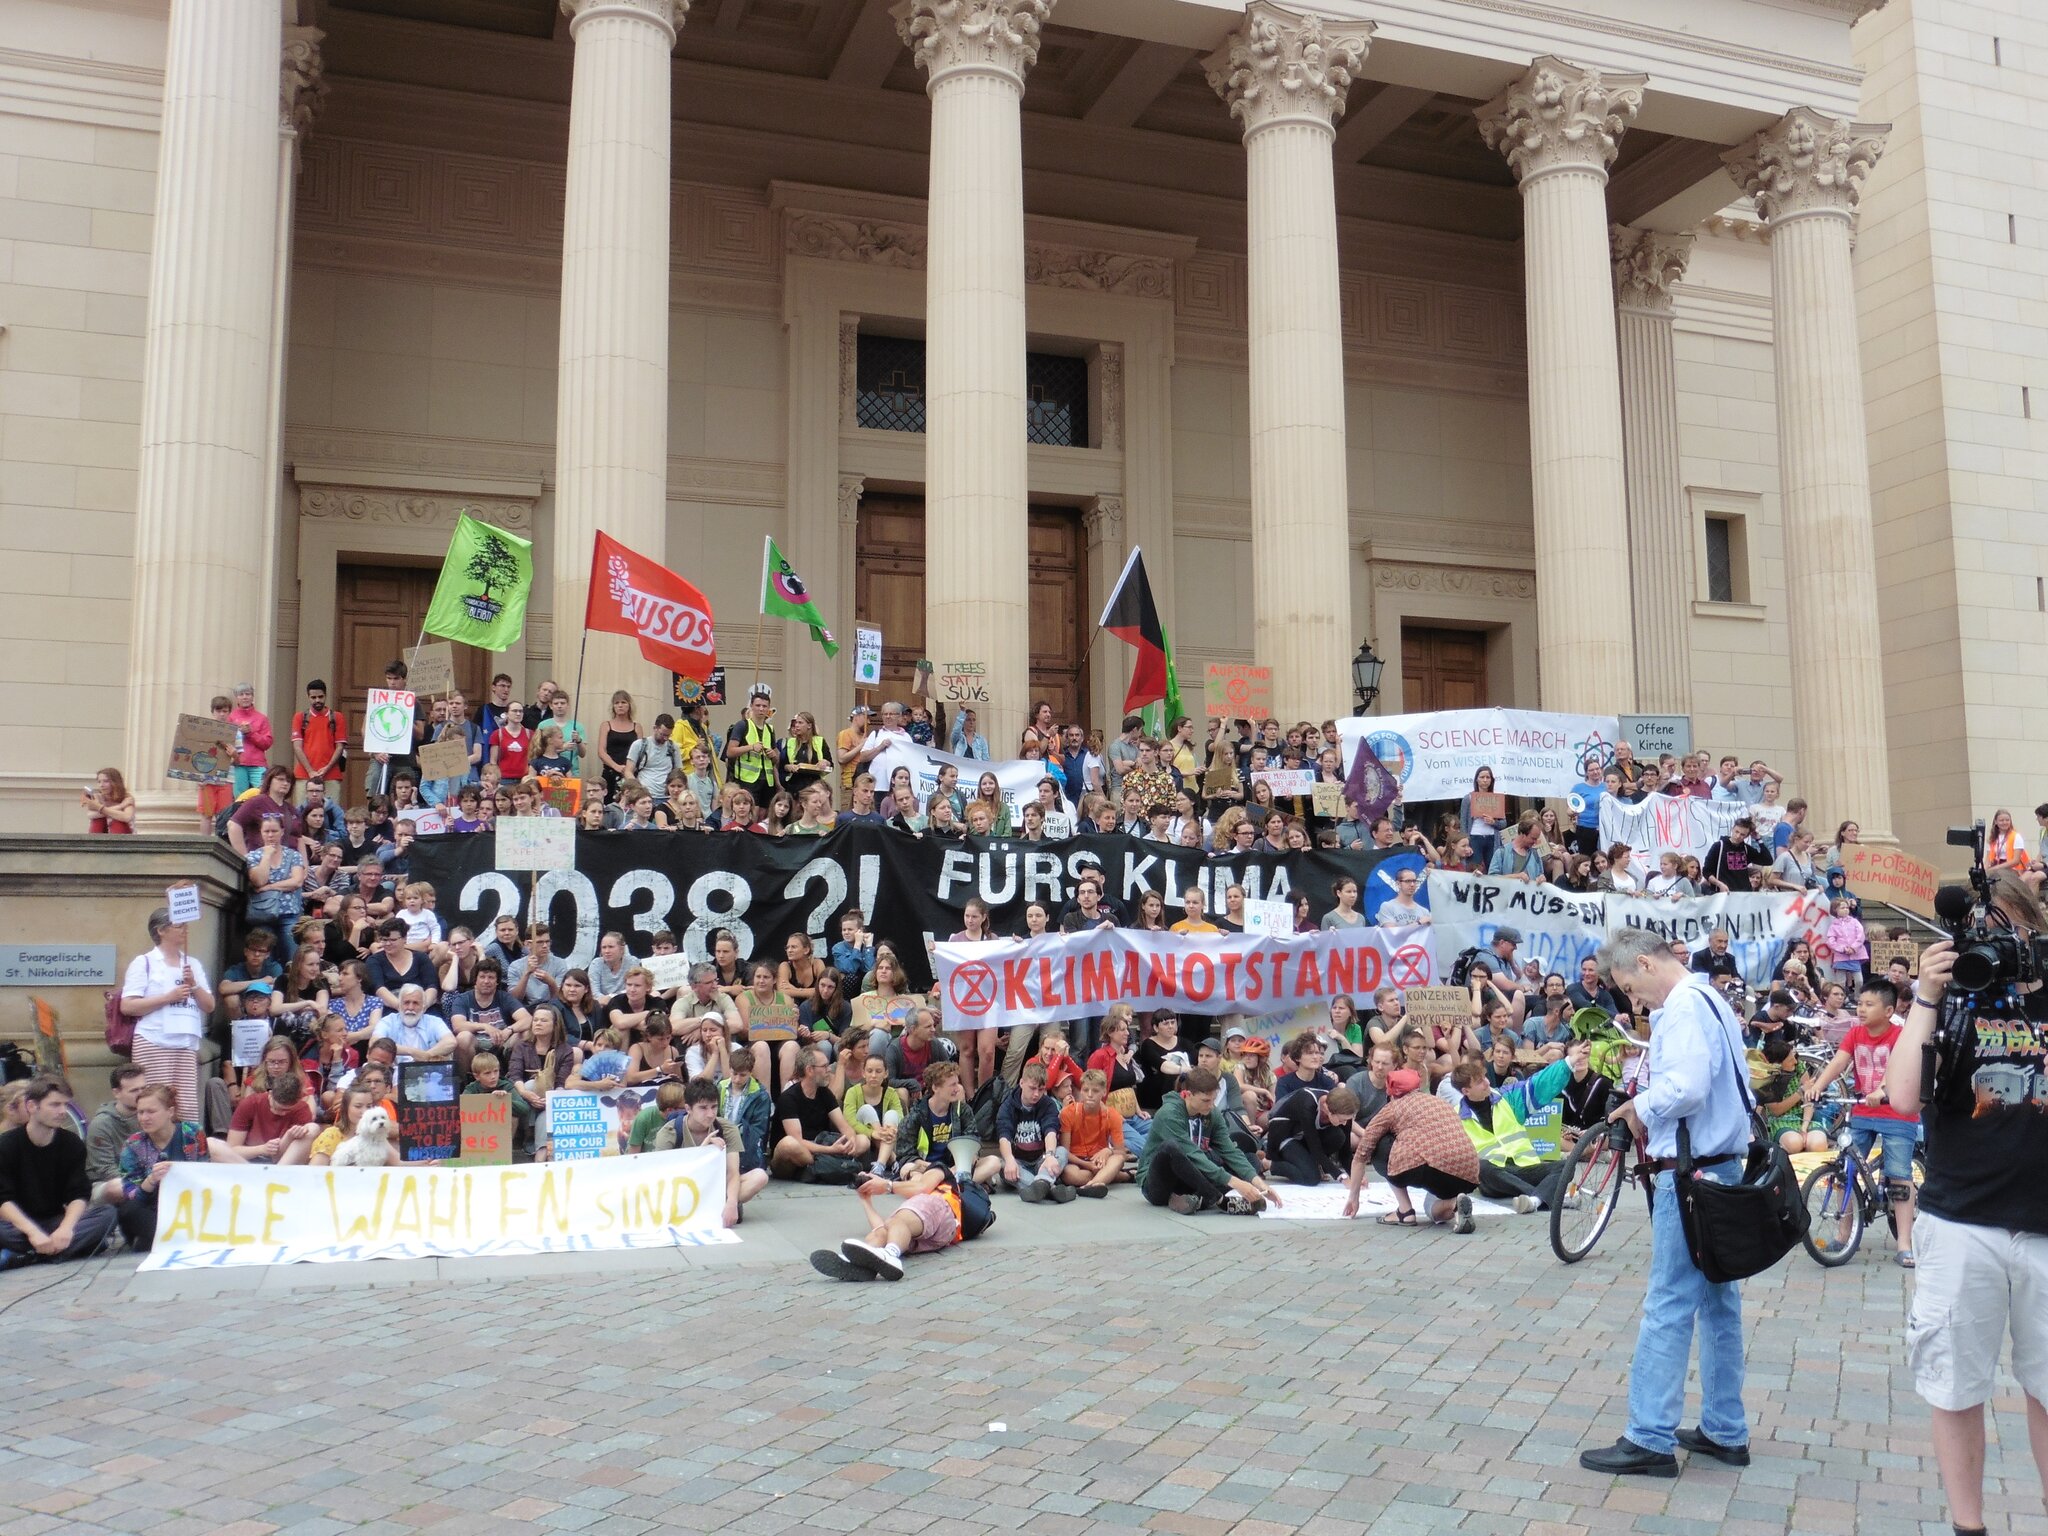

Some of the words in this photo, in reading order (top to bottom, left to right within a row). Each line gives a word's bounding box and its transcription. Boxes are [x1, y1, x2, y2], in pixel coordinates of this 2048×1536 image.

[861, 651, 877, 661] Erde
[942, 662, 986, 674] TREES
[1209, 663, 1270, 680] AUFSTAND
[940, 675, 984, 686] STATT
[945, 686, 990, 702] SUVs
[1635, 723, 1675, 735] Offene
[1418, 728, 1503, 750] SCIENCE
[1507, 729, 1566, 750] MARCH
[1639, 740, 1673, 751] Kirche
[1424, 758, 1451, 769] Vom
[1453, 755, 1497, 768] WISSEN
[1500, 757, 1515, 765] zum
[1517, 757, 1564, 769] HANDELN
[1454, 776, 1474, 785] Fakte
[1050, 826, 1068, 834] FIRST
[505, 847, 546, 857] EXPECT
[1871, 853, 1934, 885] POTSDAM
[174, 890, 193, 898] OMAS
[174, 899, 196, 907] GEGEN
[459, 868, 754, 973] 2038
[937, 842, 1102, 905] FÜRS
[1122, 851, 1292, 915] KLIMA
[1452, 880, 1501, 914] WIR
[1509, 890, 1606, 928] MÜSSEN
[173, 906, 198, 915] RECHTS
[1785, 895, 1829, 928] ACT
[1263, 911, 1292, 929] PLANET
[18, 952, 92, 965] Evangelische
[5, 968, 24, 978] St.
[27, 967, 104, 978] Nikolaikirche
[1003, 945, 1383, 1011] KLIMANOTSTAND
[1406, 990, 1462, 1001] KONZERNE
[1975, 1017, 2038, 1038] BAC
[1977, 1036, 2004, 1047] TO
[1975, 1045, 2005, 1058] THE
[553, 1097, 596, 1108] VEGAN.
[460, 1102, 507, 1124] aucht
[553, 1111, 576, 1122] FOR
[578, 1110, 598, 1121] THE
[1524, 1114, 1547, 1126] etzt!
[553, 1123, 607, 1135] ANIMALS.
[412, 1135, 433, 1147] TO
[436, 1134, 452, 1147] BE
[554, 1137, 577, 1148] FOR
[578, 1136, 604, 1147] OUR
[161, 1182, 291, 1246] ALLE
[596, 1175, 701, 1232] SIND
